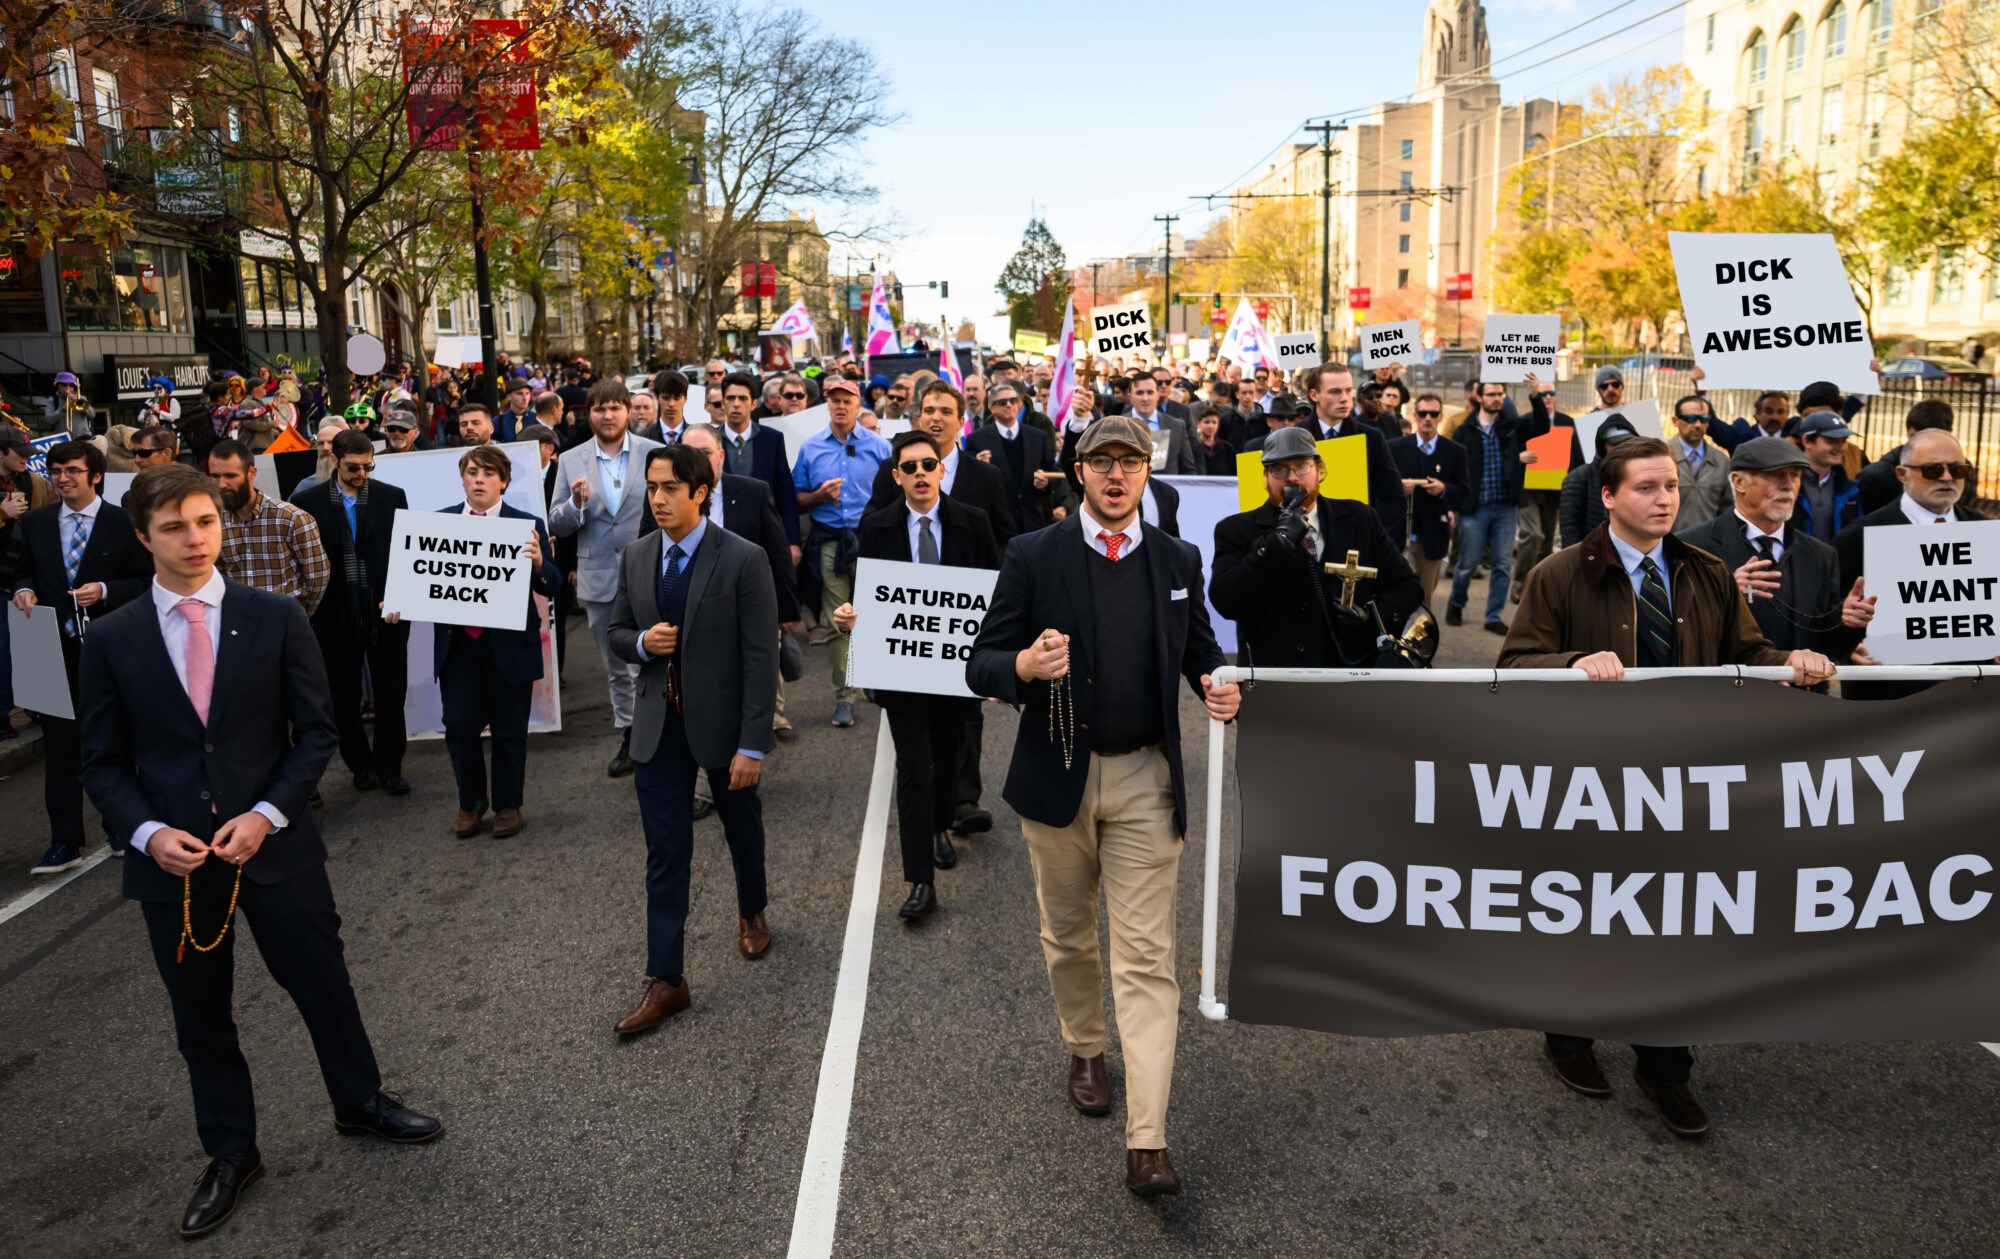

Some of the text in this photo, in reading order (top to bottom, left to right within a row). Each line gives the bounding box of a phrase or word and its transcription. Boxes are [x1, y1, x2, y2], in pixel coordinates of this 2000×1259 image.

[1715, 257, 1794, 285] DICK
[1741, 293, 1772, 317] IS
[1094, 309, 1147, 331] DICK
[1098, 331, 1150, 353] DICK
[1371, 328, 1404, 344] MEN
[1501, 333, 1540, 343] LET ME
[1702, 320, 1864, 354] AWESOME
[1280, 342, 1317, 356] DICK
[1369, 342, 1412, 360] ROCK
[1484, 344, 1556, 355] WATCH PORN
[1487, 355, 1553, 366] ON THE BUS
[117, 365, 210, 389] LOUIE'S HAIRCUTS
[404, 534, 523, 560] I WANT MY
[1919, 541, 1973, 567] WE
[412, 559, 517, 583] CUSTODY
[429, 583, 489, 604] BACK
[875, 585, 988, 612] SATURDA
[1897, 577, 1998, 604] WANT
[892, 613, 980, 637] ARE FO
[1905, 613, 1996, 641] BEER
[886, 638, 975, 662] THE BO
[1414, 749, 1926, 832] I WANT MY
[1281, 854, 1993, 936] FORESKIN BAC
